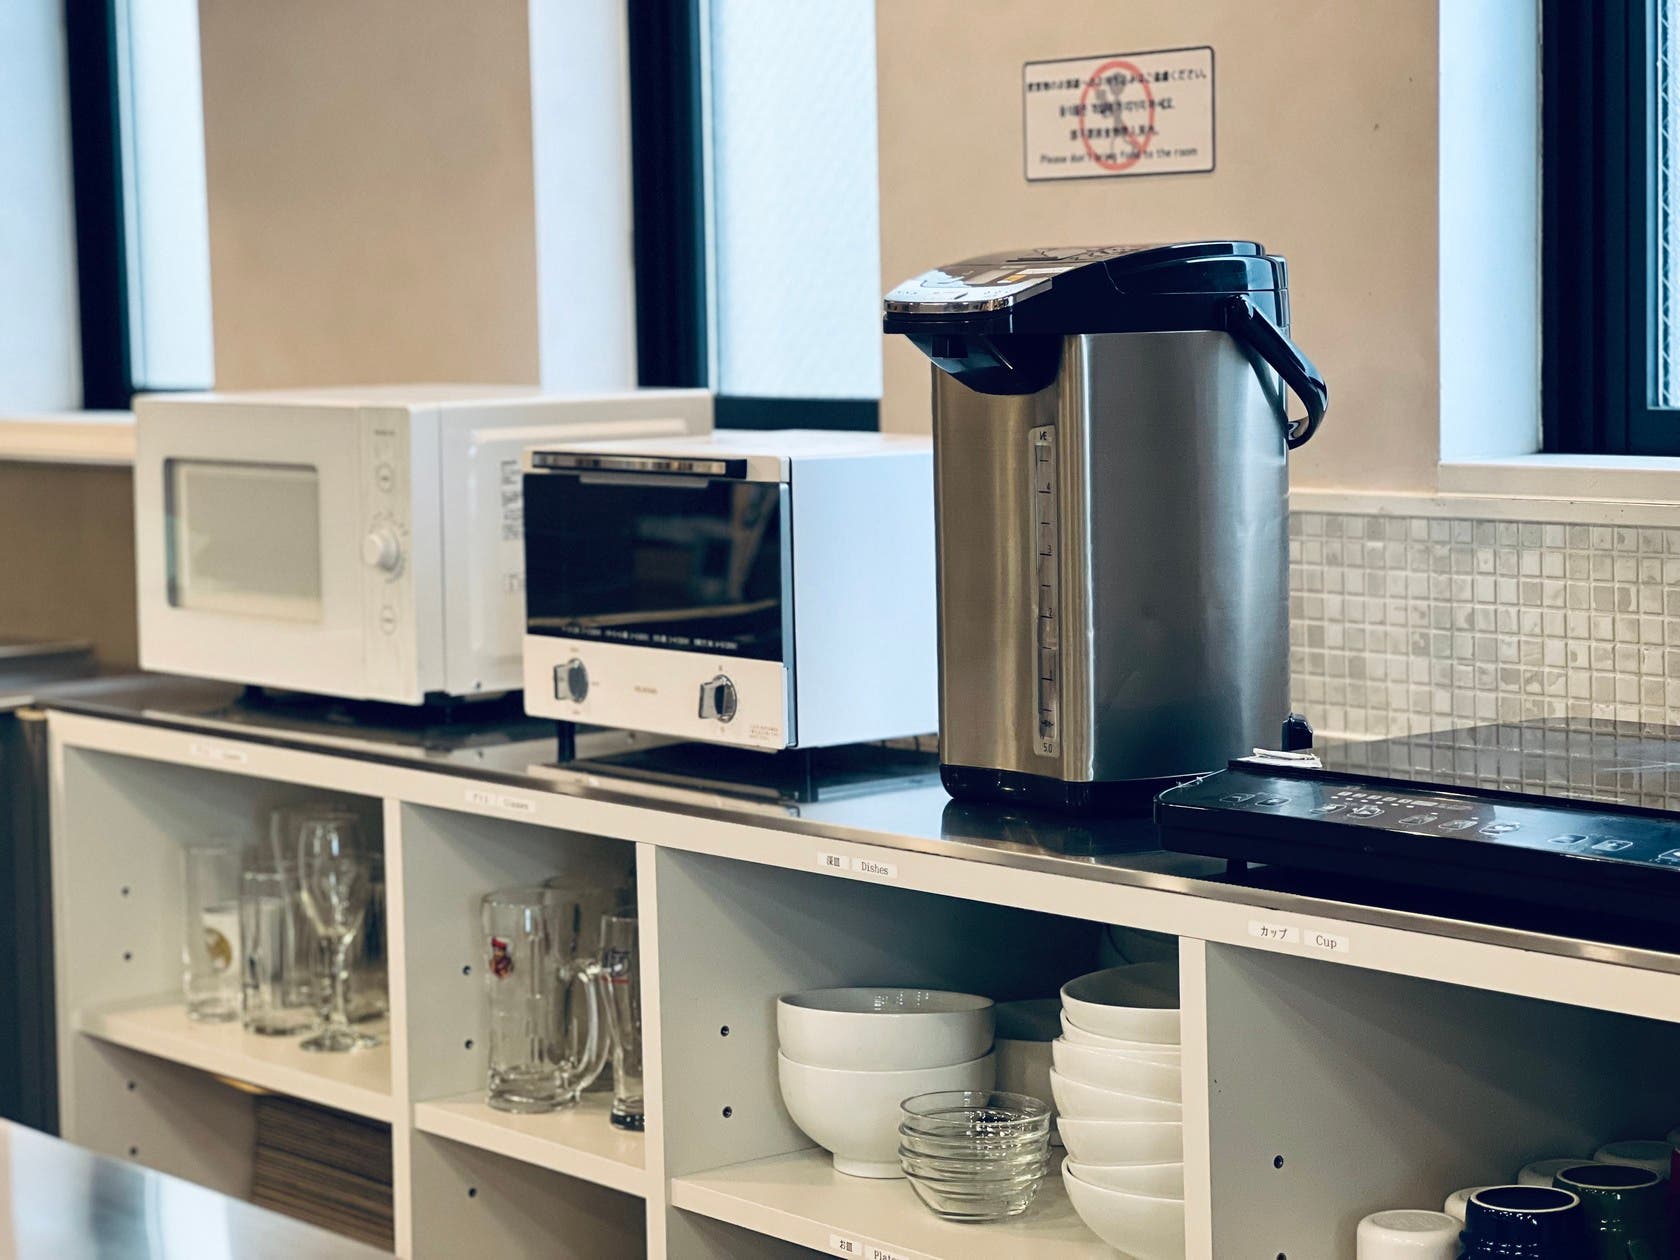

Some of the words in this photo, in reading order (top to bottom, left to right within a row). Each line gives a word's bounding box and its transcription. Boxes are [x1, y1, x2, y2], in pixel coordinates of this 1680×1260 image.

[1040, 153, 1067, 165] Please
[1143, 149, 1153, 159] to
[1156, 147, 1171, 158] the
[1174, 147, 1197, 157] room
[861, 861, 888, 875] Dishes
[1260, 925, 1288, 940] カップ
[1316, 935, 1337, 949] Cup
[874, 1249, 899, 1260] Plat
